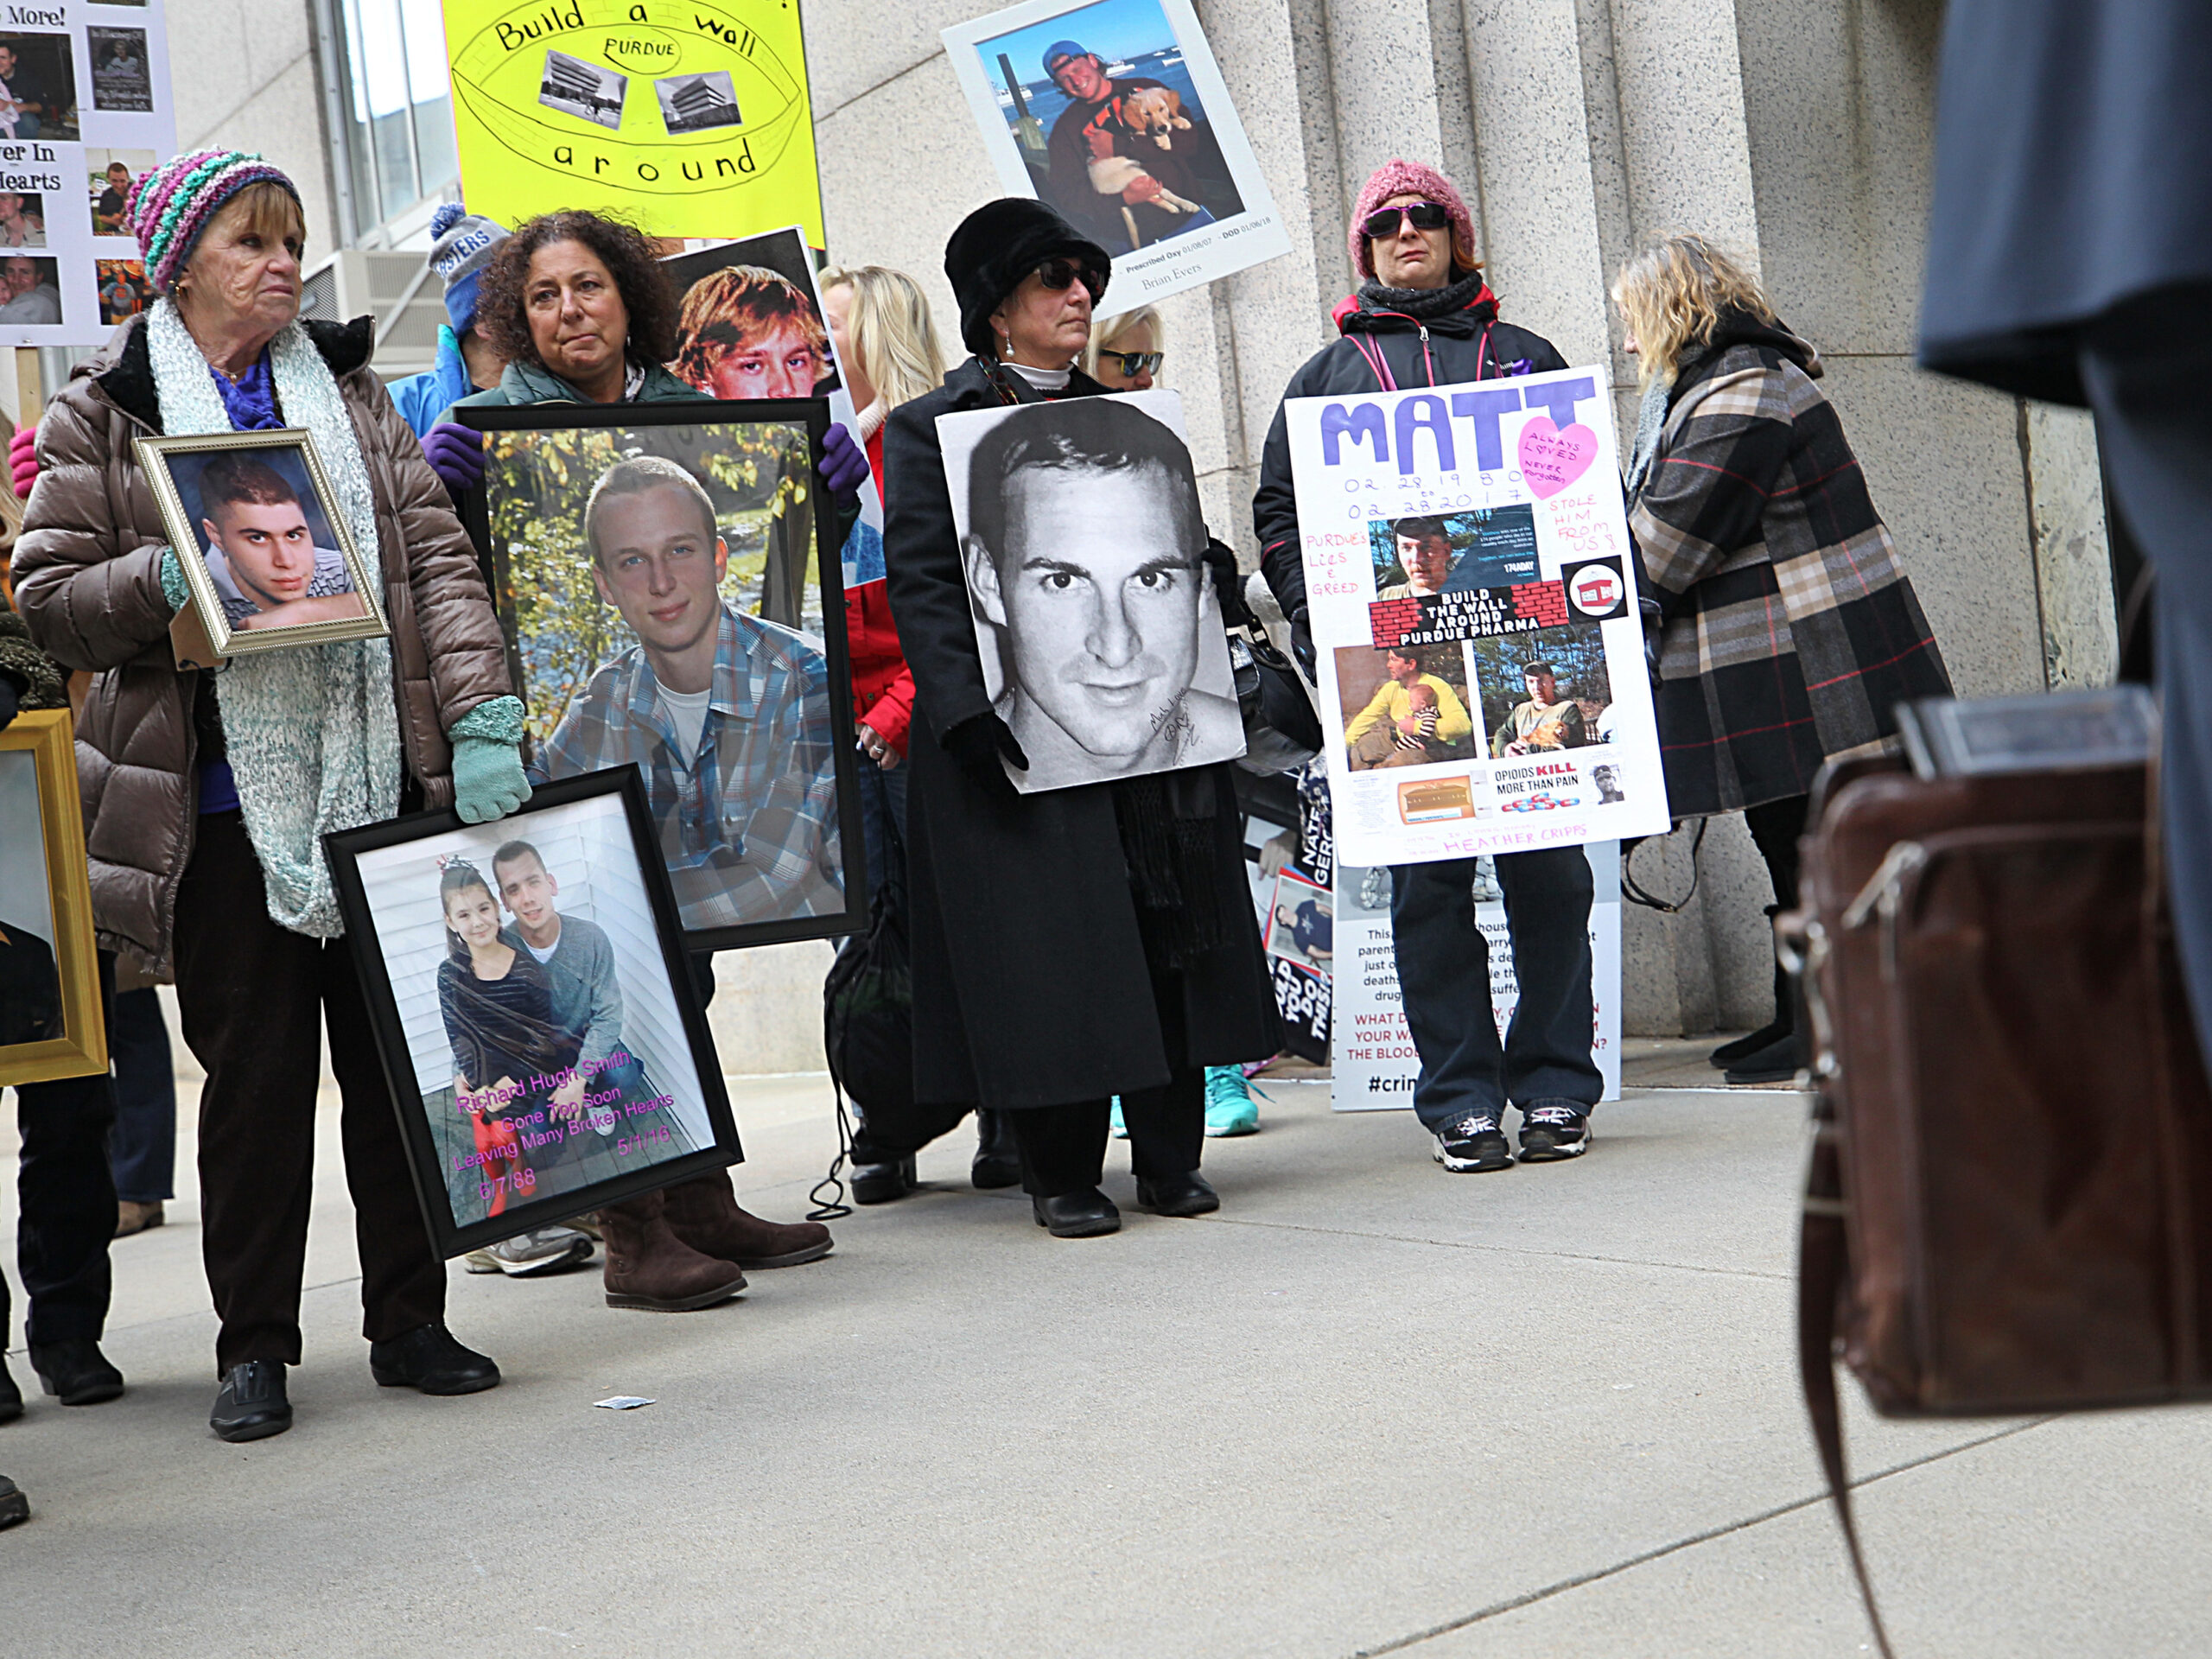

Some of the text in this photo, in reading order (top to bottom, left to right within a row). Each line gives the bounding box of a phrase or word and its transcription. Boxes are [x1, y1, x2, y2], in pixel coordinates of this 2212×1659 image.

[8, 5, 66, 26] More!
[495, 0, 756, 58] Build a wall
[605, 37, 675, 56] PURDUE
[32, 143, 55, 162] In
[1126, 254, 1166, 274] Prescribed
[1166, 249, 1182, 260] Oxy
[1222, 227, 1241, 239] DOD
[1141, 263, 1203, 291] Brian Evers
[1320, 376, 1597, 475] MATT
[1549, 494, 1597, 511] STOLE
[1555, 509, 1590, 525] HIM
[1573, 536, 1599, 551] US
[1313, 582, 1359, 596] GREED
[1441, 588, 1491, 605] BUILD
[1427, 598, 1508, 619] THE WALL
[1435, 611, 1503, 630] AROUND
[1400, 617, 1540, 646] PURDUE PHARMA
[1495, 762, 1577, 781] OPIOIDS KILL
[1497, 774, 1579, 795] MORE THAN PAIN
[1443, 832, 1536, 853] HEATHER
[1541, 823, 1587, 841] CRIPPS
[1367, 929, 1391, 940] This
[1364, 960, 1385, 973] just
[1285, 975, 1303, 1023] YOU
[1300, 978, 1318, 1019] DO
[1355, 1013, 1395, 1025] WHAT
[1355, 1030, 1392, 1043] YOUR
[1347, 1048, 1372, 1060] THE
[454, 1050, 632, 1115] Richard Hugh Smith
[501, 1087, 622, 1133] Gone Too Soon
[453, 1093, 674, 1171] Leaving Many Broken Hearts
[479, 1125, 671, 1201] 6/7/88 5/1/16
